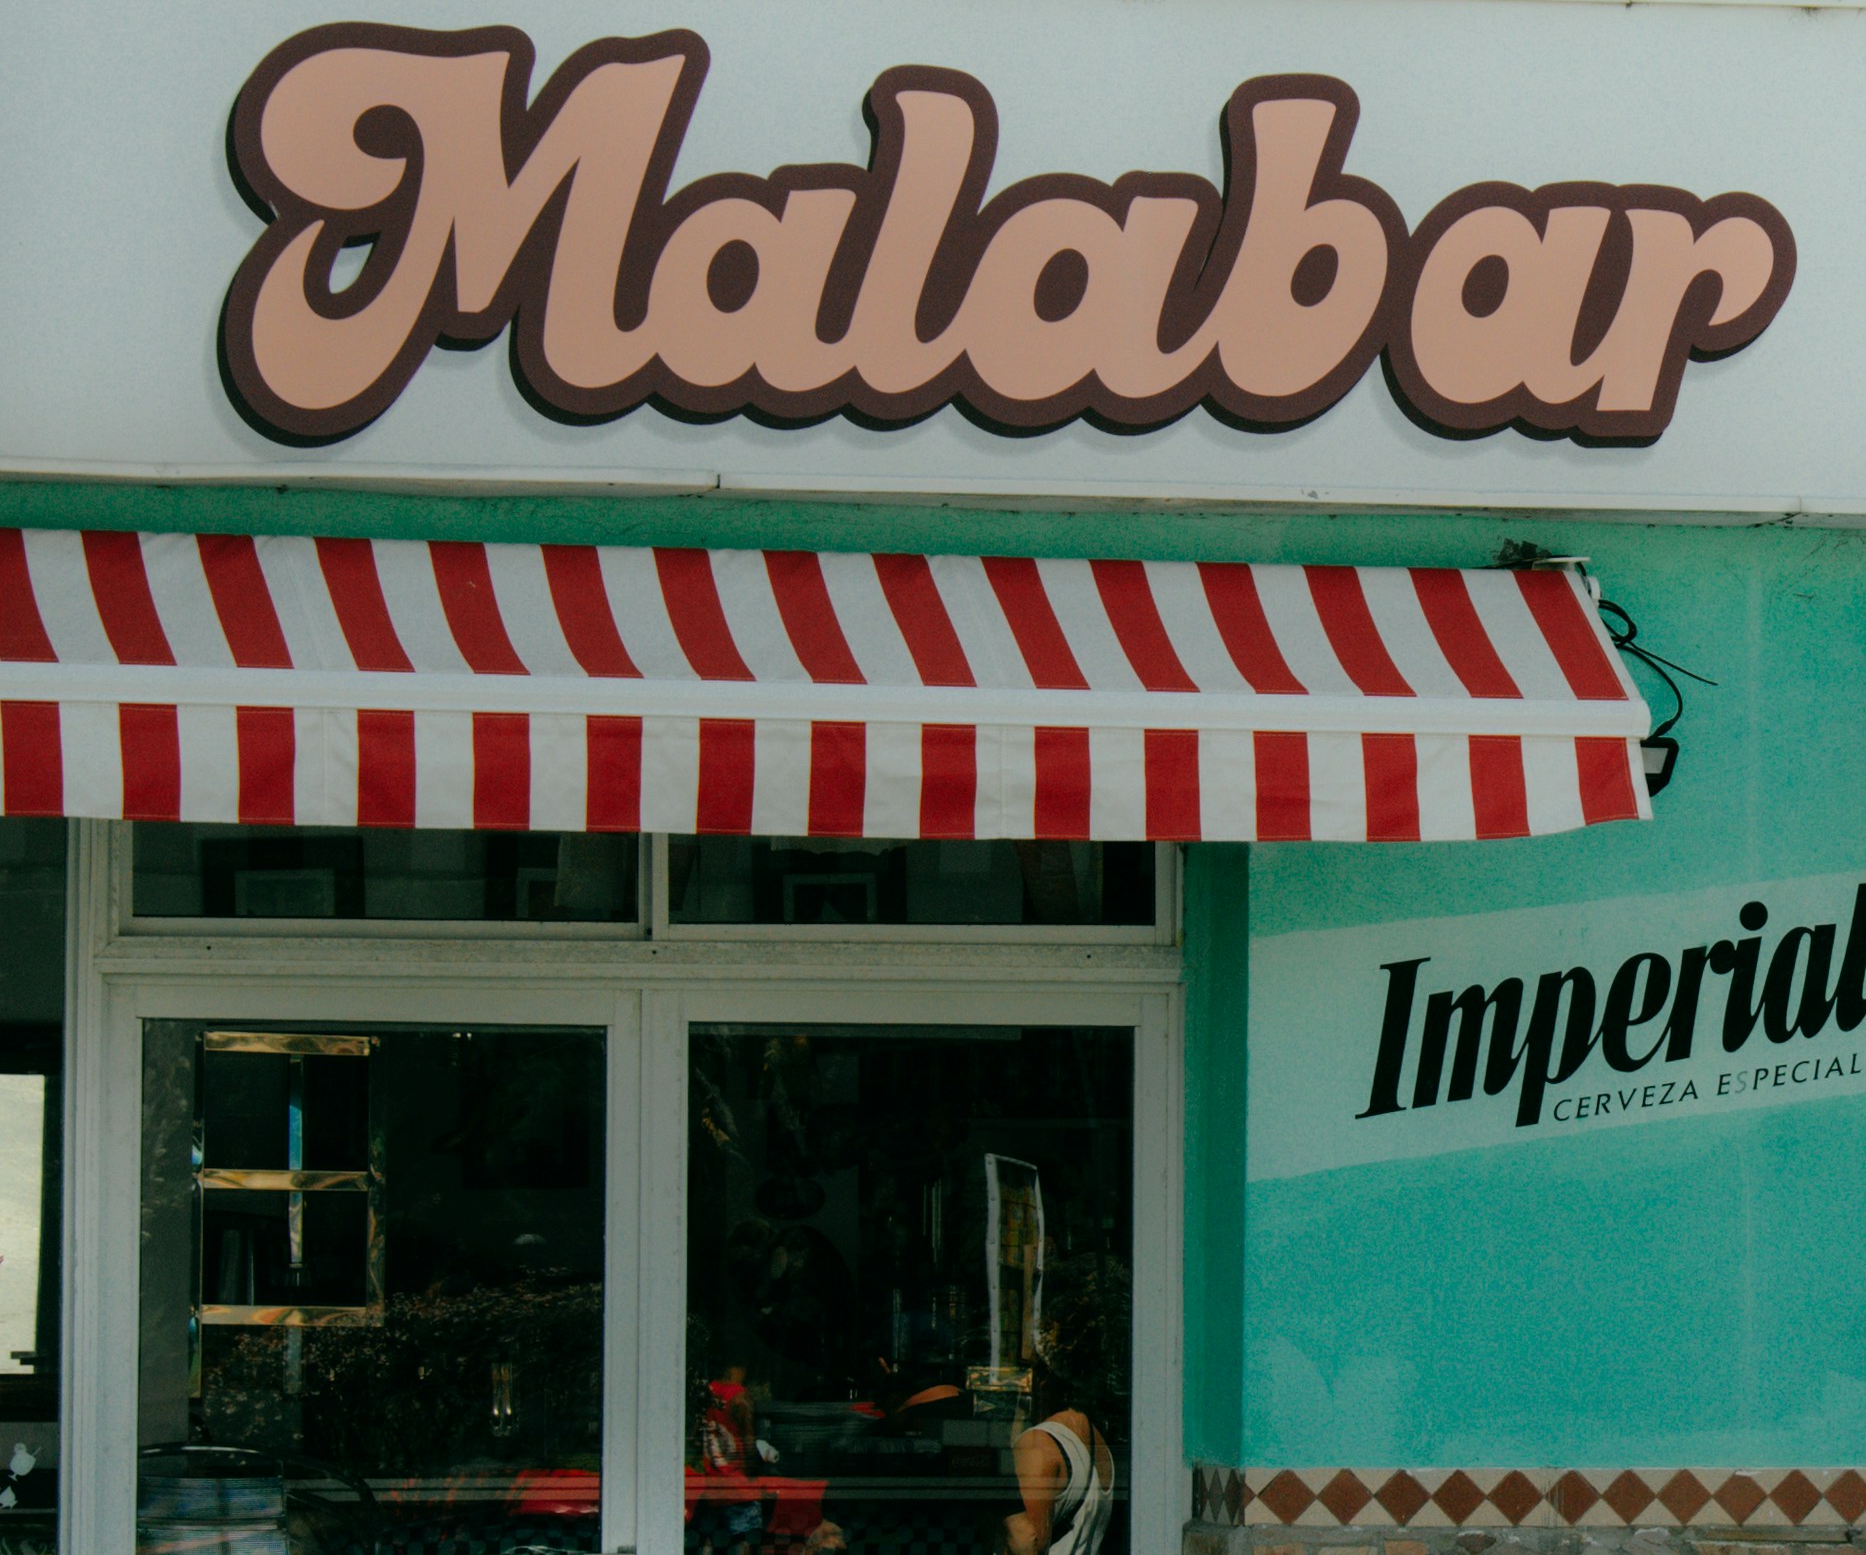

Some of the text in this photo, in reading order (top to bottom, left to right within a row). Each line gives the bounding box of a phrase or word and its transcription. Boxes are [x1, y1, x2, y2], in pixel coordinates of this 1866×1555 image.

[220, 19, 1797, 445] Malabar
[1553, 1052, 1863, 1123] CERVEZA ESPECIAL
